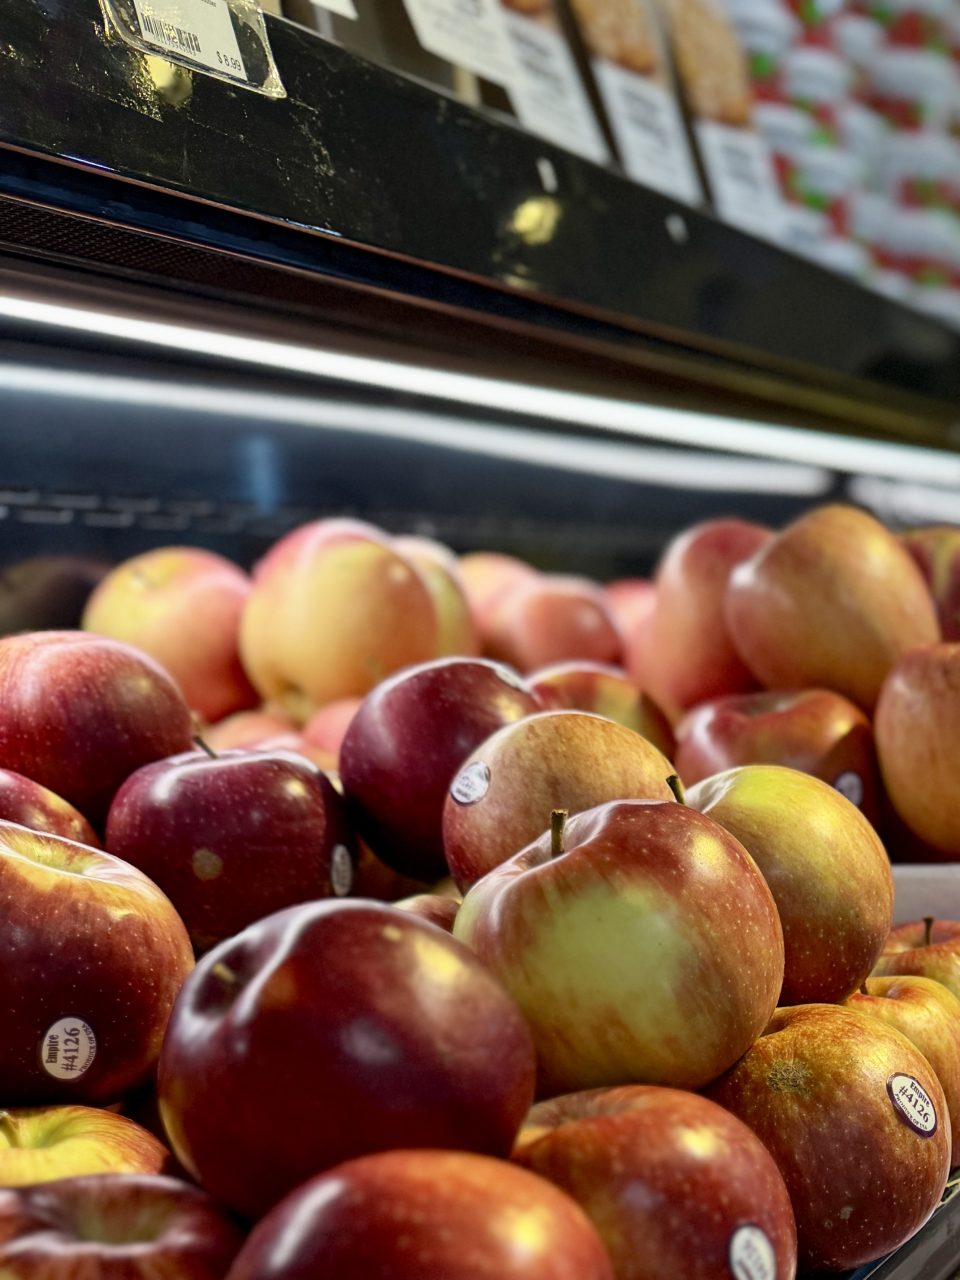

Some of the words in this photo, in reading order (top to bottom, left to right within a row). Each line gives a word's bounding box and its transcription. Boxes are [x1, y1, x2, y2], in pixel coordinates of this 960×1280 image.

[45, 1034, 60, 1064] Empire
[60, 1027, 81, 1071] #4126
[898, 1085, 930, 1123] #4126
[910, 1081, 930, 1108] Empire
